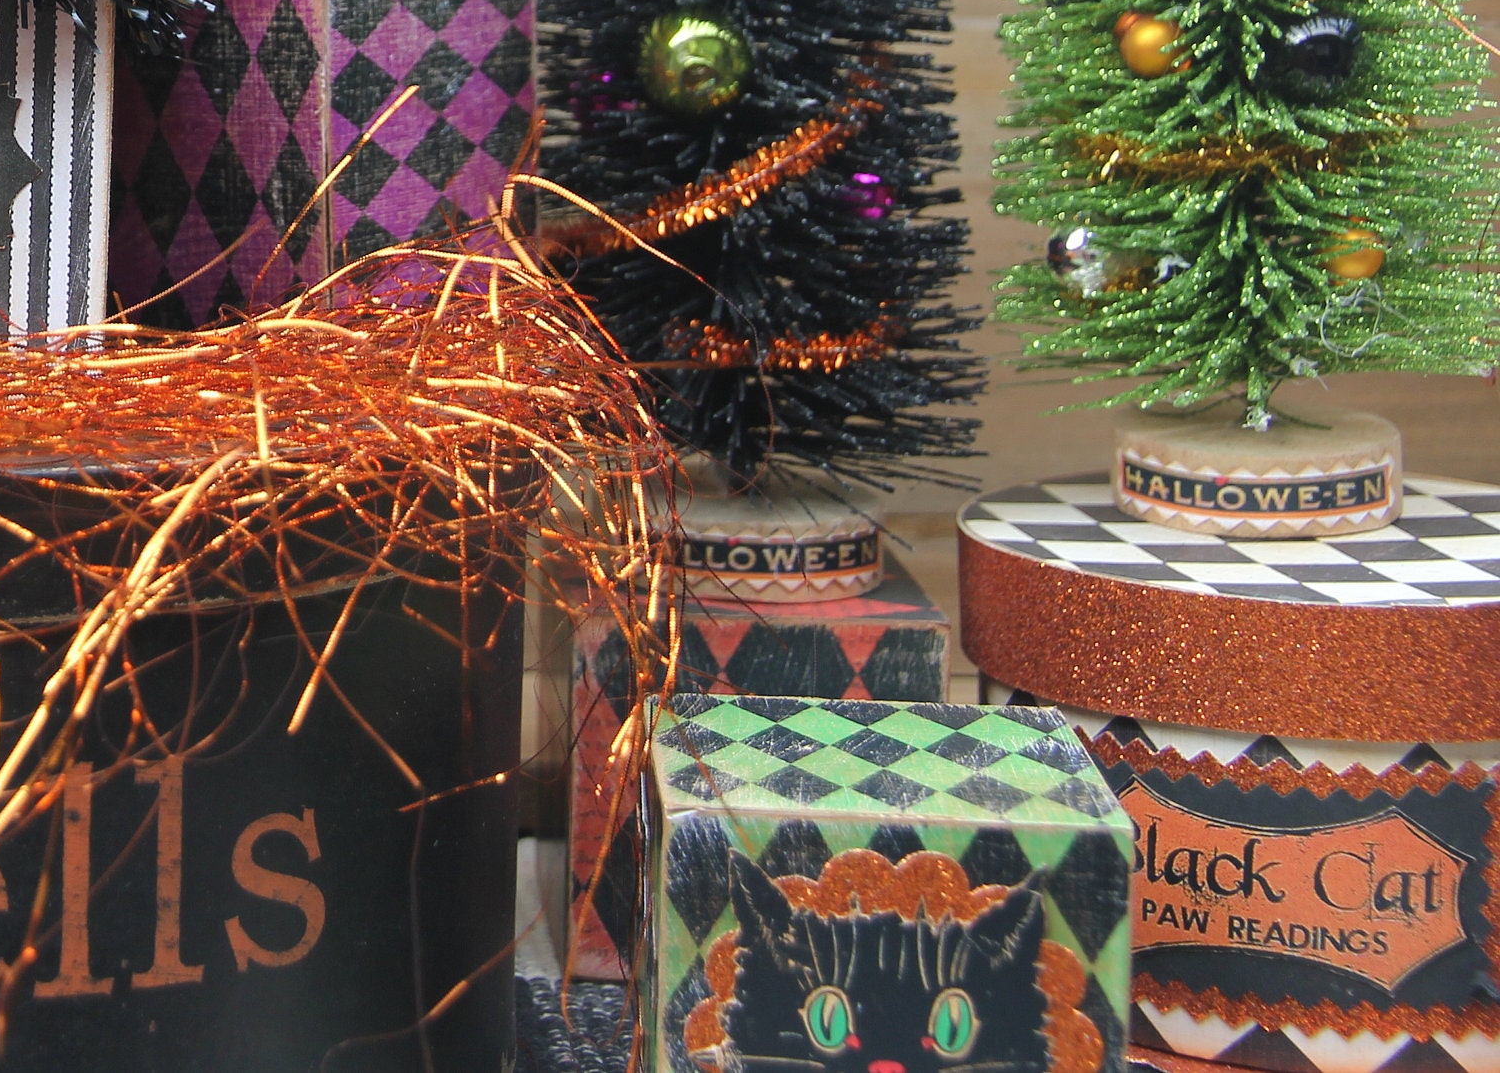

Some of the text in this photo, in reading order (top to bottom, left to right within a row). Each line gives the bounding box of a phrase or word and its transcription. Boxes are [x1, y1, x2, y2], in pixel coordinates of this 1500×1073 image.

[1125, 465, 1384, 511] HALLOWE-EN
[683, 540, 875, 572] LLOWE-EN
[1313, 846, 1445, 917] Cat
[1141, 898, 1389, 956] PAW READINGS
